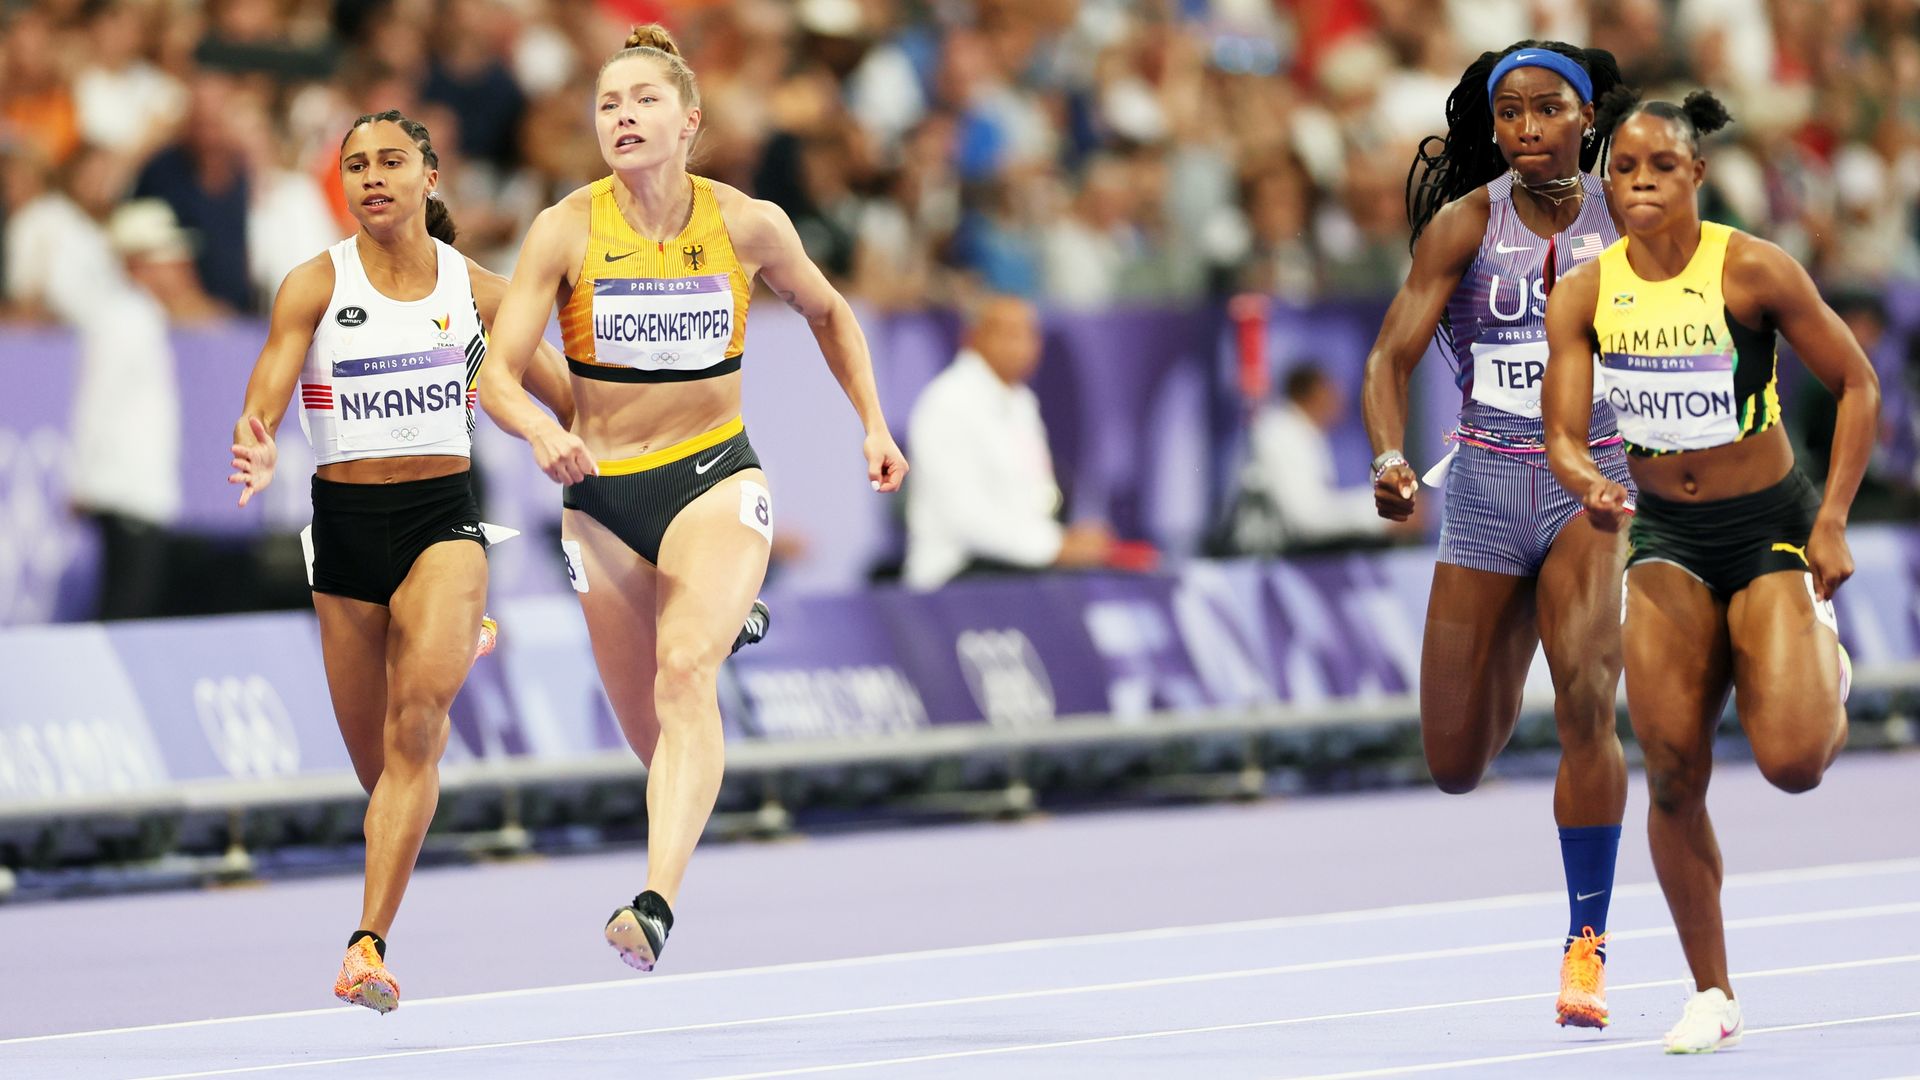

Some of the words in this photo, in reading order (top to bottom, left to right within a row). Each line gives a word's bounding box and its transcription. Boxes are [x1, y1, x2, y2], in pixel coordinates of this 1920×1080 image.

[629, 282, 665, 291] PARIS
[668, 281, 700, 291] 2024
[595, 309, 729, 342] LUECKENKEMPER
[1498, 331, 1532, 341] PARIS
[1609, 324, 1717, 354] JAMAICA
[363, 359, 398, 371] PARIS
[401, 355, 432, 367] 2024
[1627, 356, 1658, 368] PARIS
[1661, 358, 1695, 369] 2024
[340, 380, 461, 421] NKANSA
[1609, 387, 1731, 420] CLAYTON
[754, 495, 769, 527] 8
